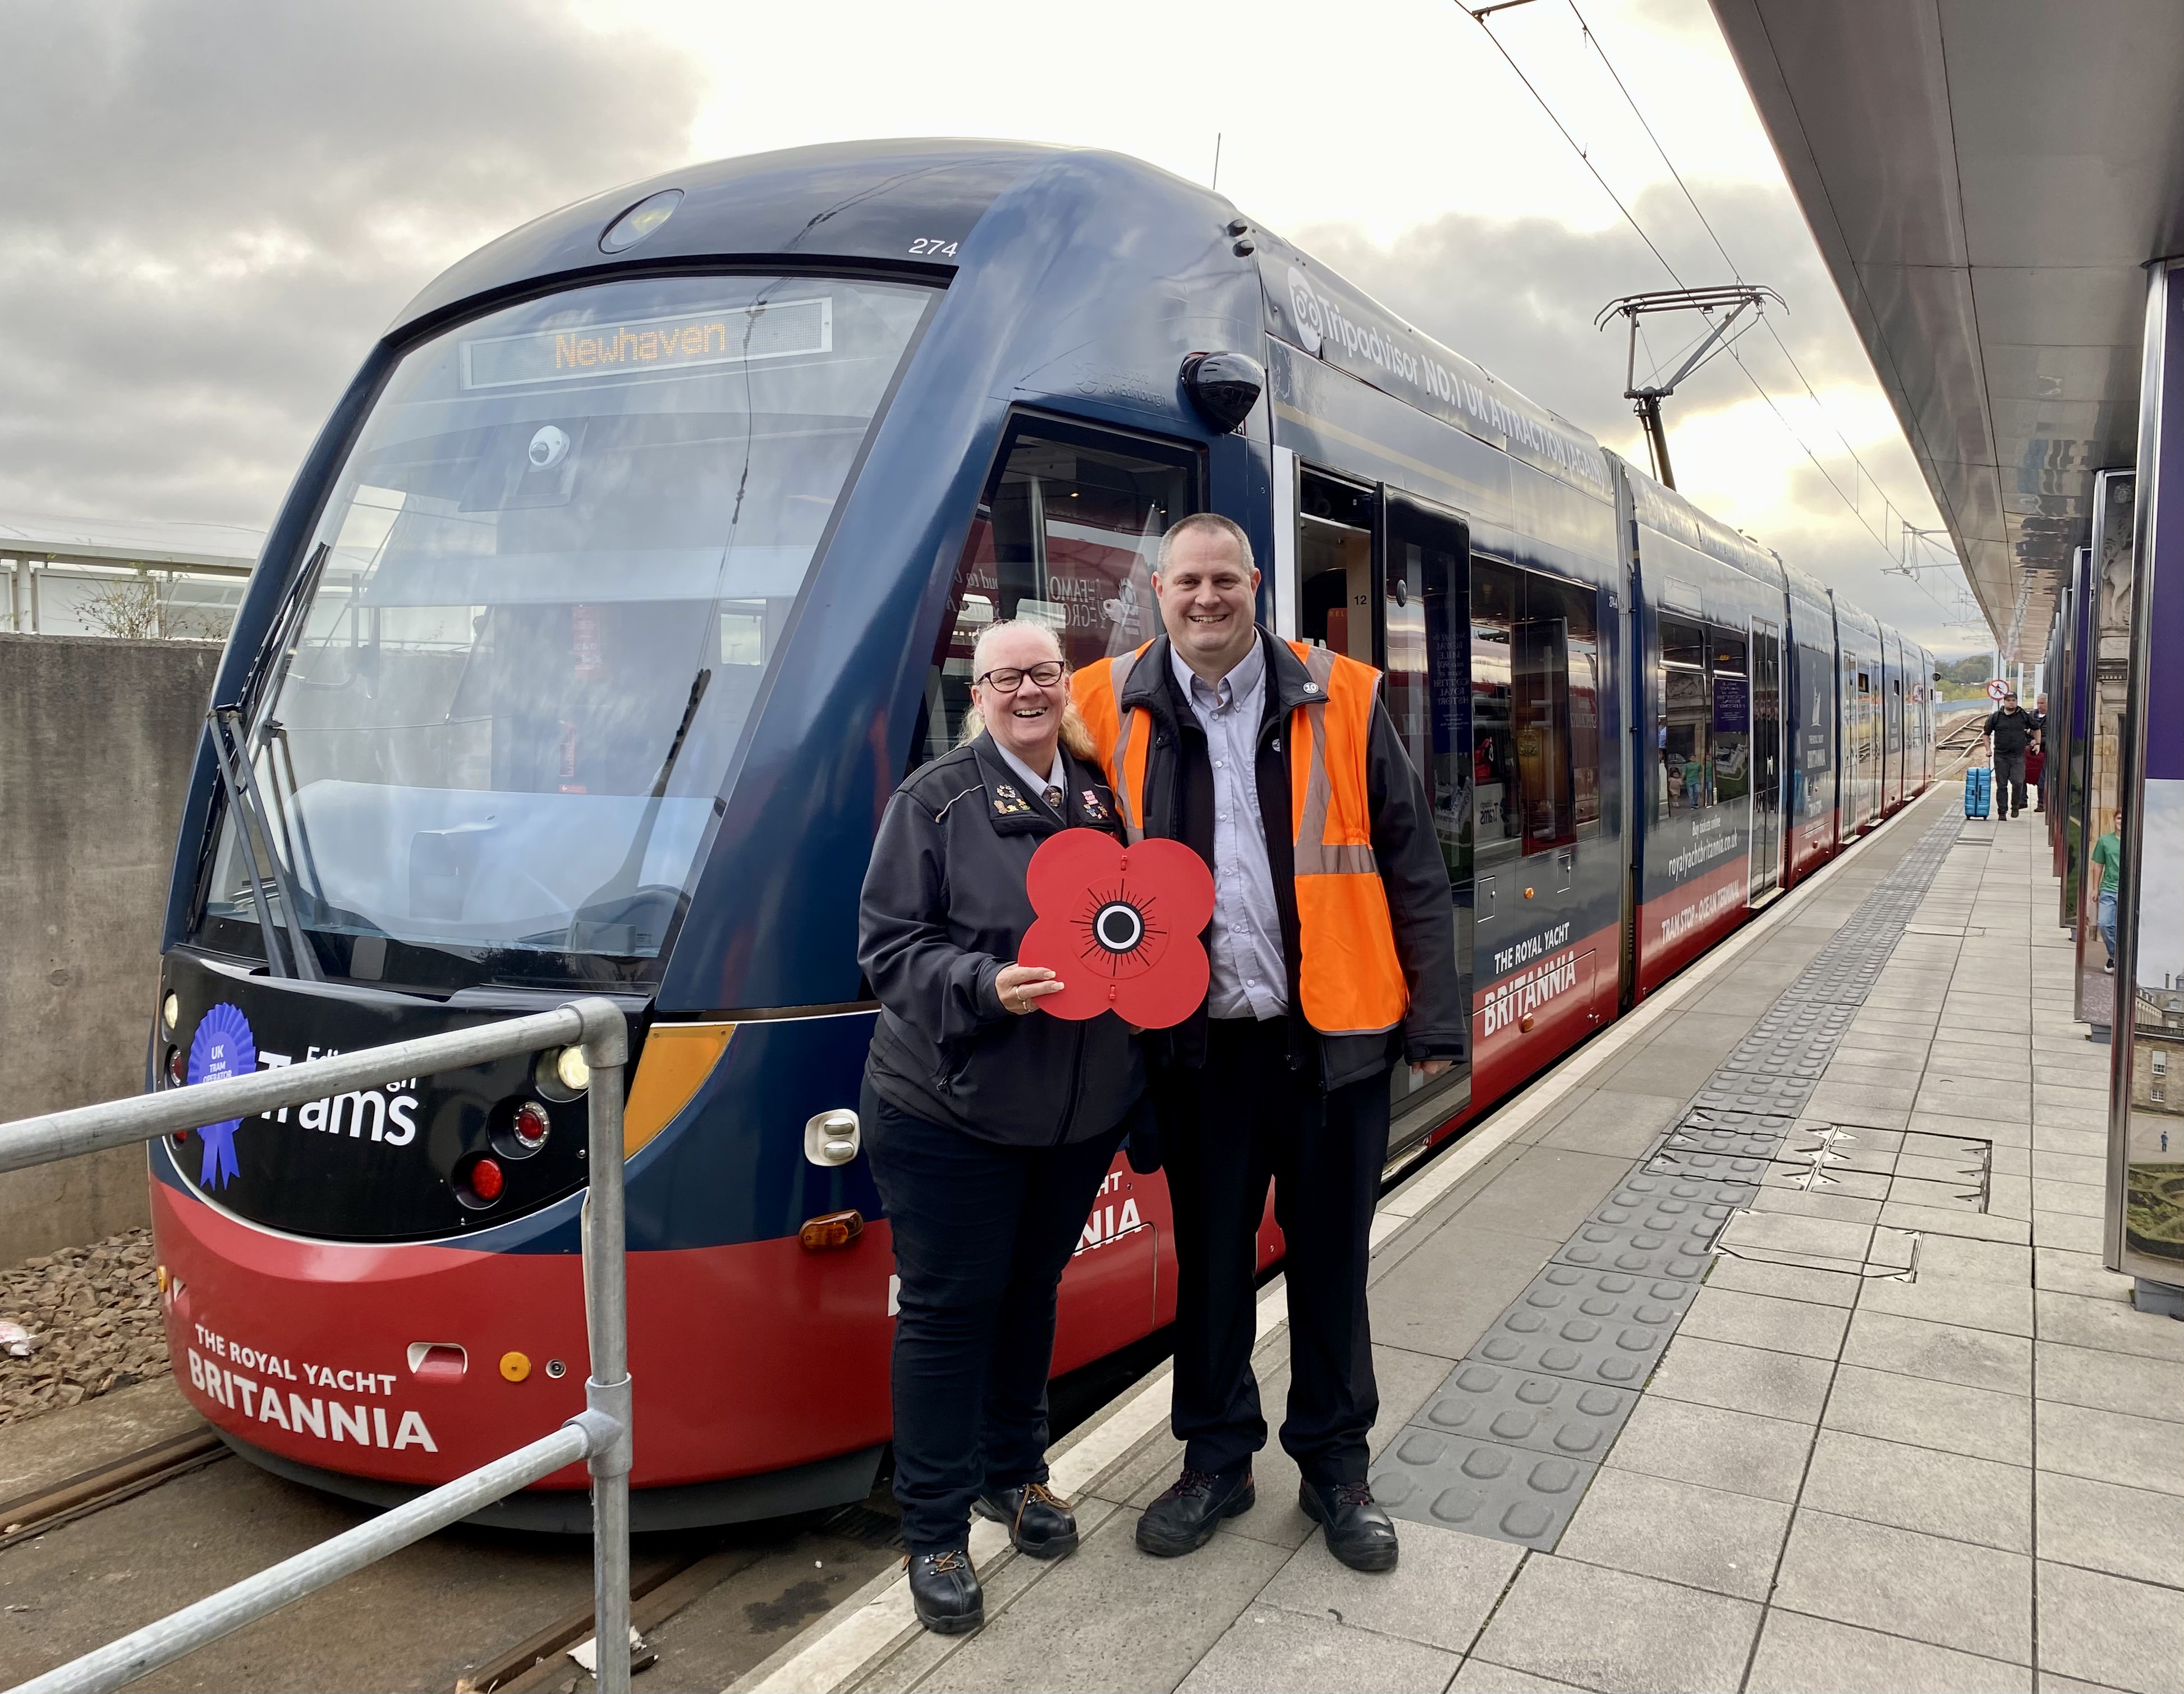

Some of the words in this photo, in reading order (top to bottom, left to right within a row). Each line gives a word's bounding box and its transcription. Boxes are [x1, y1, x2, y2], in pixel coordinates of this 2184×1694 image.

[907, 238, 958, 258] 274
[555, 321, 727, 369] Newhaven
[1316, 295, 1419, 385] Tripadvisor
[1421, 354, 1462, 409] NO.1
[1462, 378, 1489, 424] UK
[1489, 395, 1565, 463] ATTRACTION
[1566, 441, 1605, 496] (AGAIN)
[1353, 595, 1368, 605] 12
[1668, 826, 1738, 882] royalyachtbritannia.co.uk
[1661, 912, 1680, 945] TRAM
[1680, 904, 1696, 934] STOP
[1699, 891, 1717, 922] OCEAN
[1717, 879, 1740, 910] TERMINAL
[1494, 947, 1513, 975] THE
[1515, 934, 1542, 965] ROYAL
[1544, 921, 1570, 951] YACHT
[1484, 950, 1576, 1037] BRITANNIA
[209, 1061, 226, 1073] TRAM
[211, 1044, 224, 1060] UK
[195, 1323, 226, 1357] THE
[229, 1341, 297, 1381] ROYAL
[302, 1362, 397, 1395] YACHT
[187, 1347, 438, 1453] BRITANNIA
